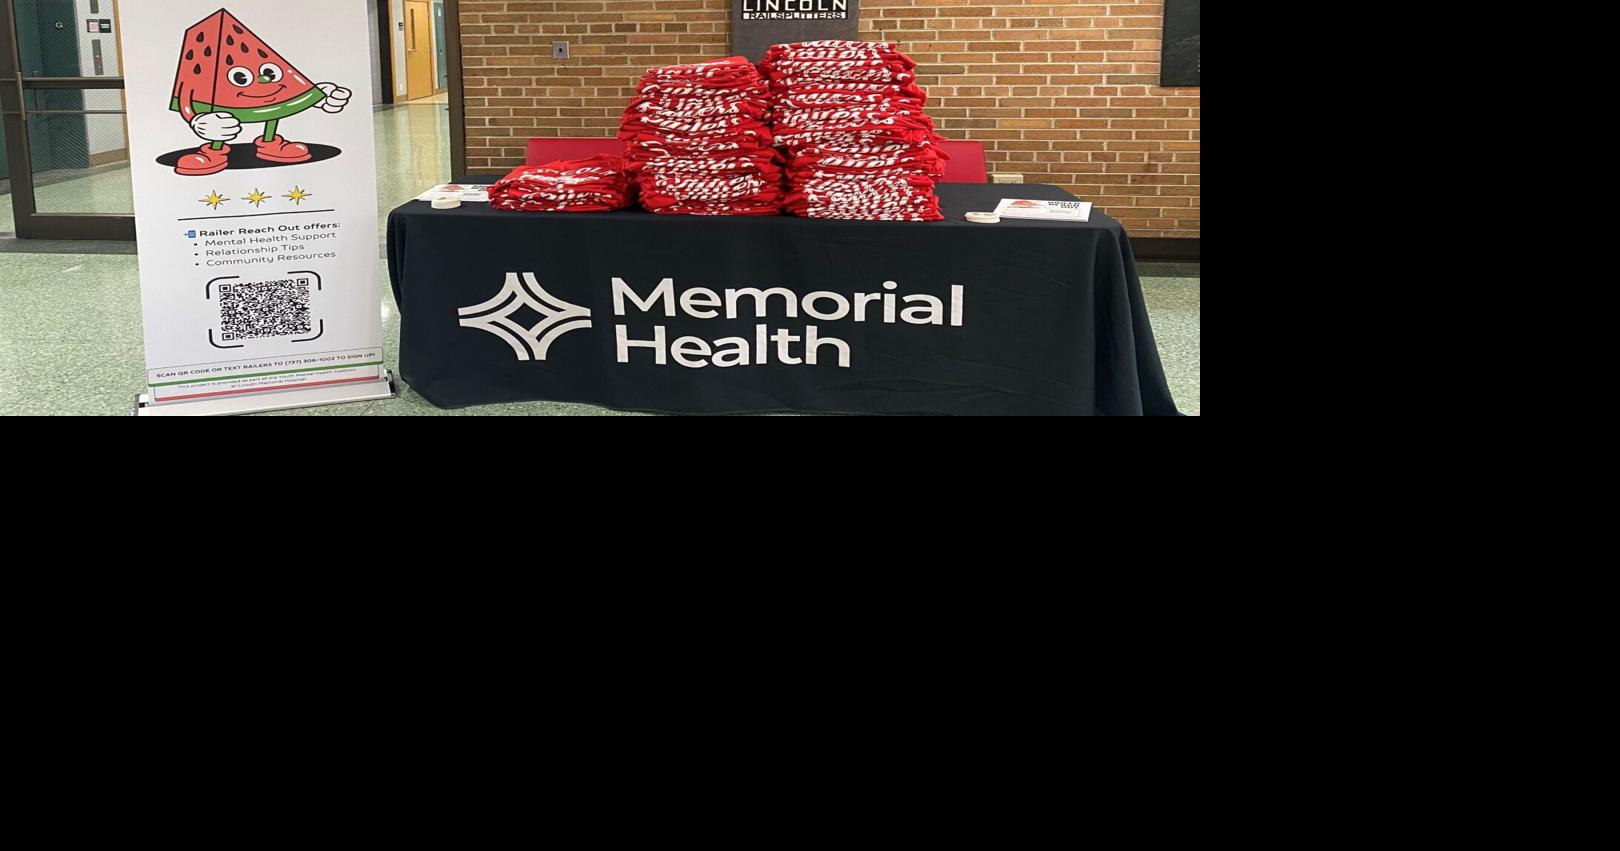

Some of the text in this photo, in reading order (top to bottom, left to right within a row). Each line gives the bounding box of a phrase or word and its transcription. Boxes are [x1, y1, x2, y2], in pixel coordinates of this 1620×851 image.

[743, 0, 847, 11] LINCOLN
[199, 221, 341, 238] Railer Reach Out offers:
[205, 231, 336, 247] Mental Health Support
[206, 243, 305, 257] Relationship Tips
[206, 250, 336, 268] Community Resources
[611, 276, 964, 328] Memorial
[615, 323, 851, 368] Health
[243, 362, 273, 370] RAILERS
